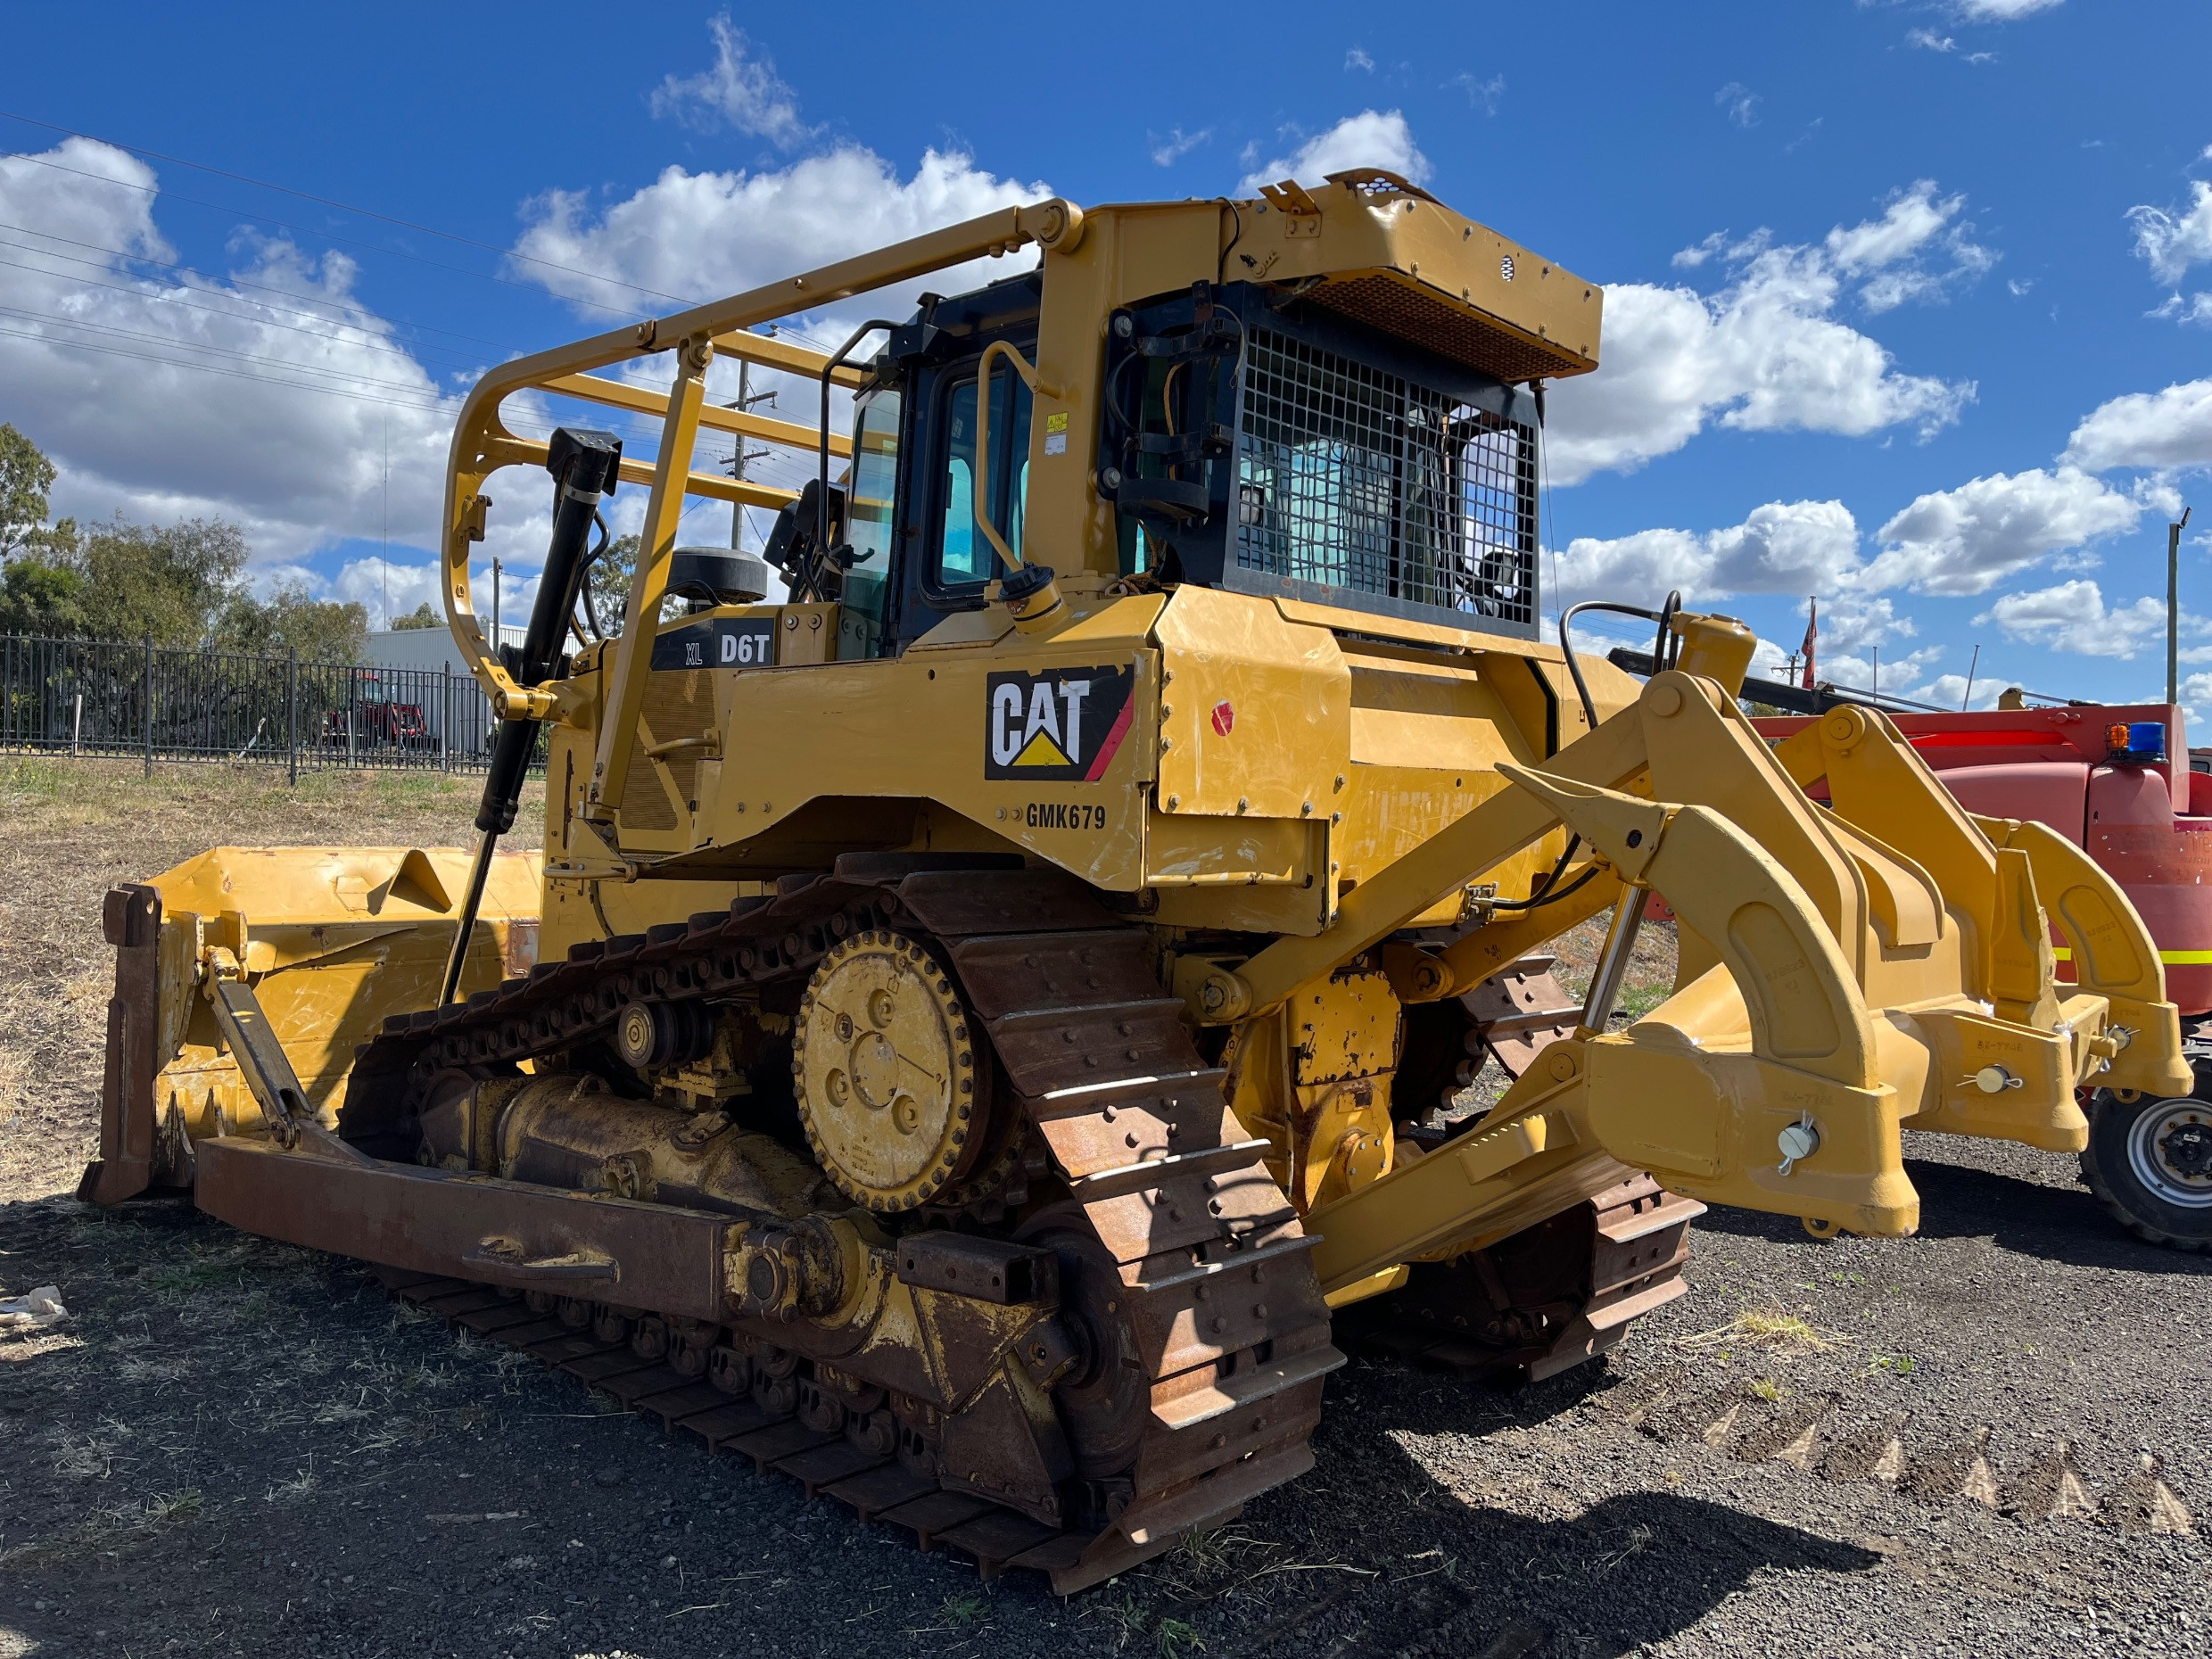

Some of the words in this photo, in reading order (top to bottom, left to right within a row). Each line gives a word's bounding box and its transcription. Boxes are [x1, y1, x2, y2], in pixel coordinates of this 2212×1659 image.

[686, 642, 703, 665] XL
[722, 634, 770, 663] D6T
[993, 680, 1090, 766] CAT
[1027, 804, 1105, 830] GMK679
